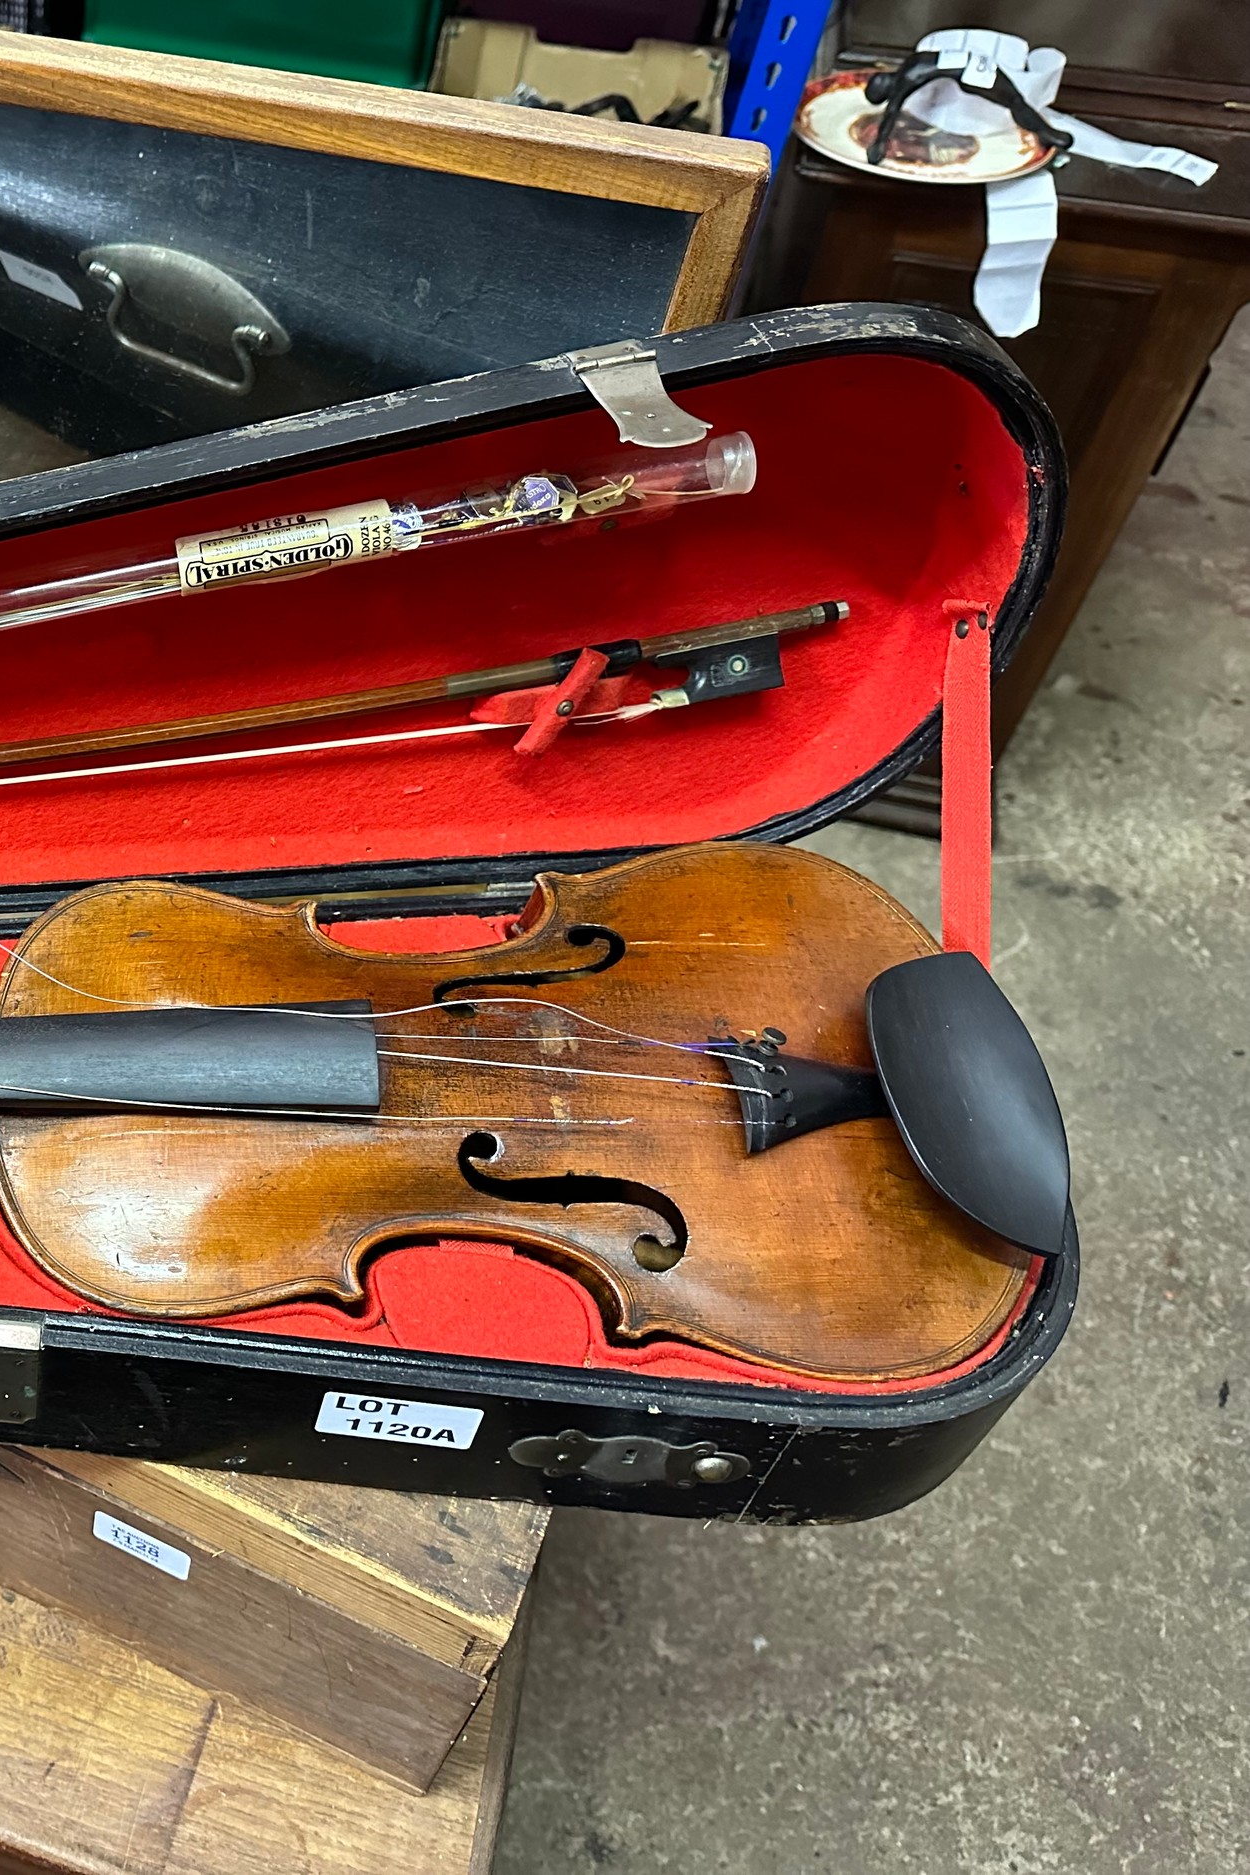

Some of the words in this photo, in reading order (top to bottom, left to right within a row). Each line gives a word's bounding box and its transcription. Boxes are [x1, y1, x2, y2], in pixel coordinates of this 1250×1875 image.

[263, 526, 292, 536] MUSICAL
[371, 525, 380, 556] VIOLA
[336, 1396, 409, 1416] LOT
[346, 1418, 455, 1443] 1120A
[110, 1529, 159, 1558] 1128
